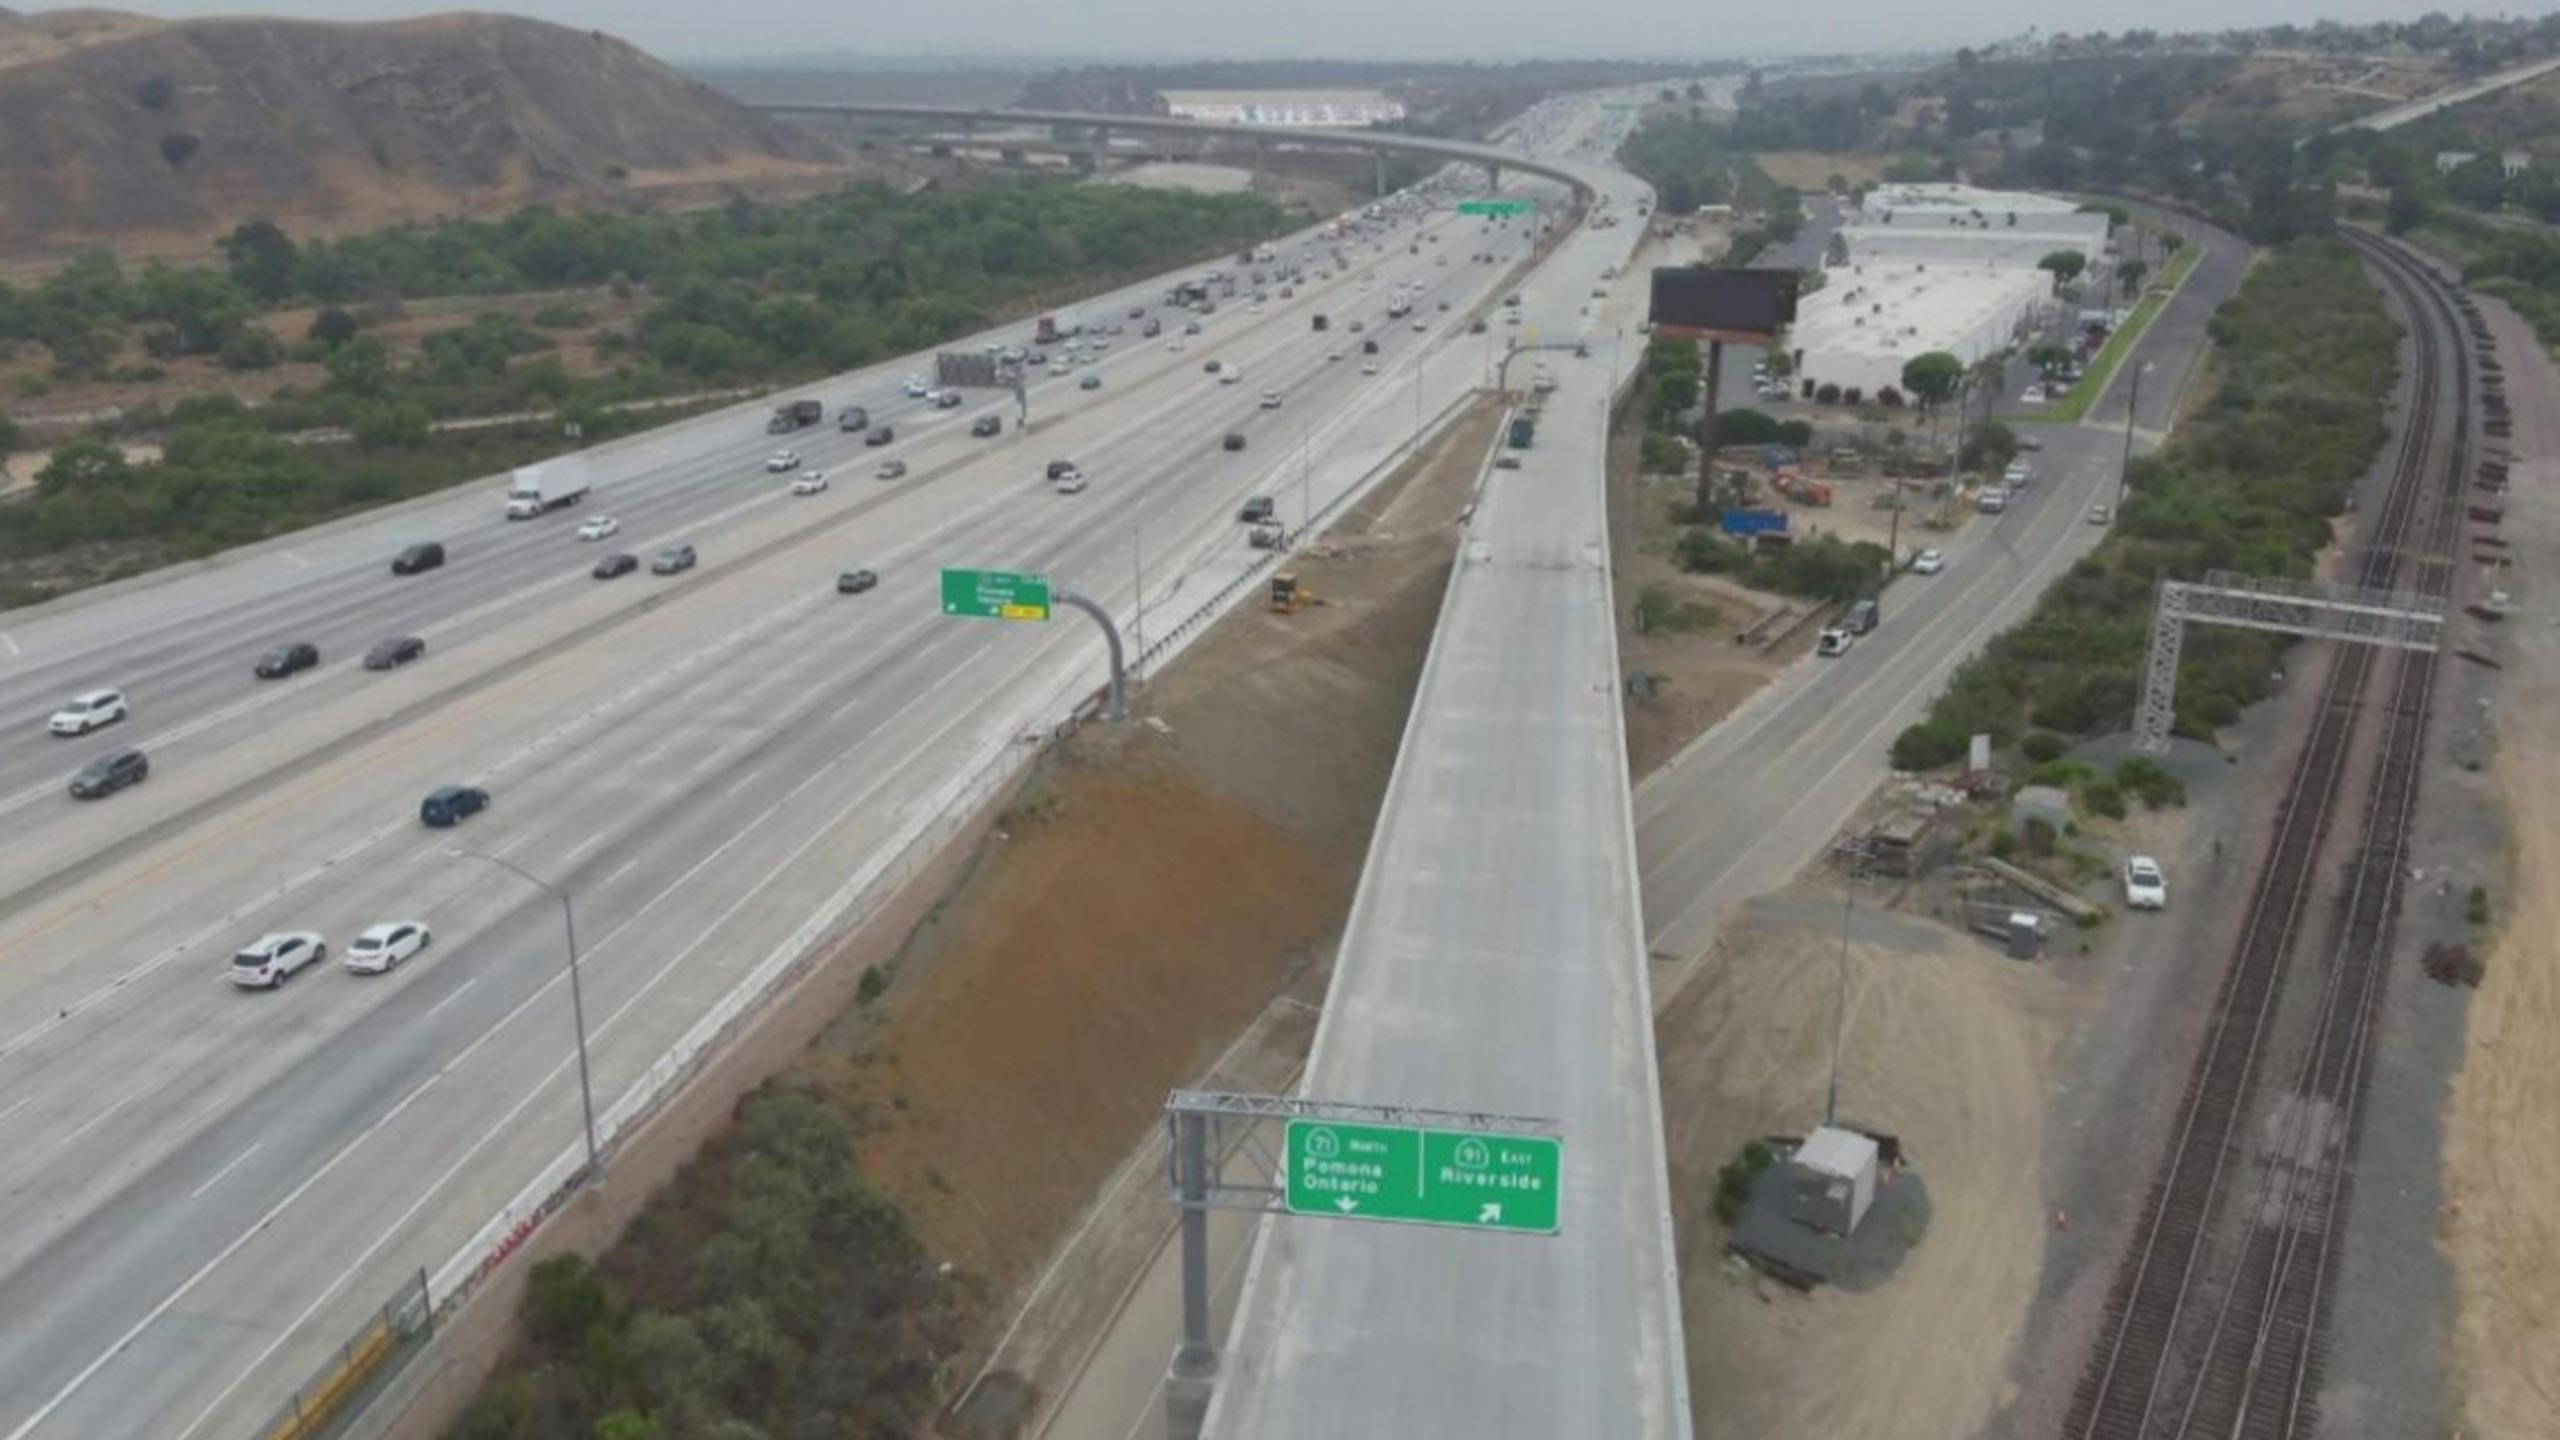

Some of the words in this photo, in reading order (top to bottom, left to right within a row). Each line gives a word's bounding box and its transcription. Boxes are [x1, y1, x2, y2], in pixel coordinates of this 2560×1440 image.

[1463, 1146, 1481, 1162] 91
[1501, 1150, 1532, 1165] EAST
[1303, 1157, 1382, 1178] Pomona
[1303, 1173, 1378, 1194] Ontario
[1440, 1167, 1542, 1190] Riverside
